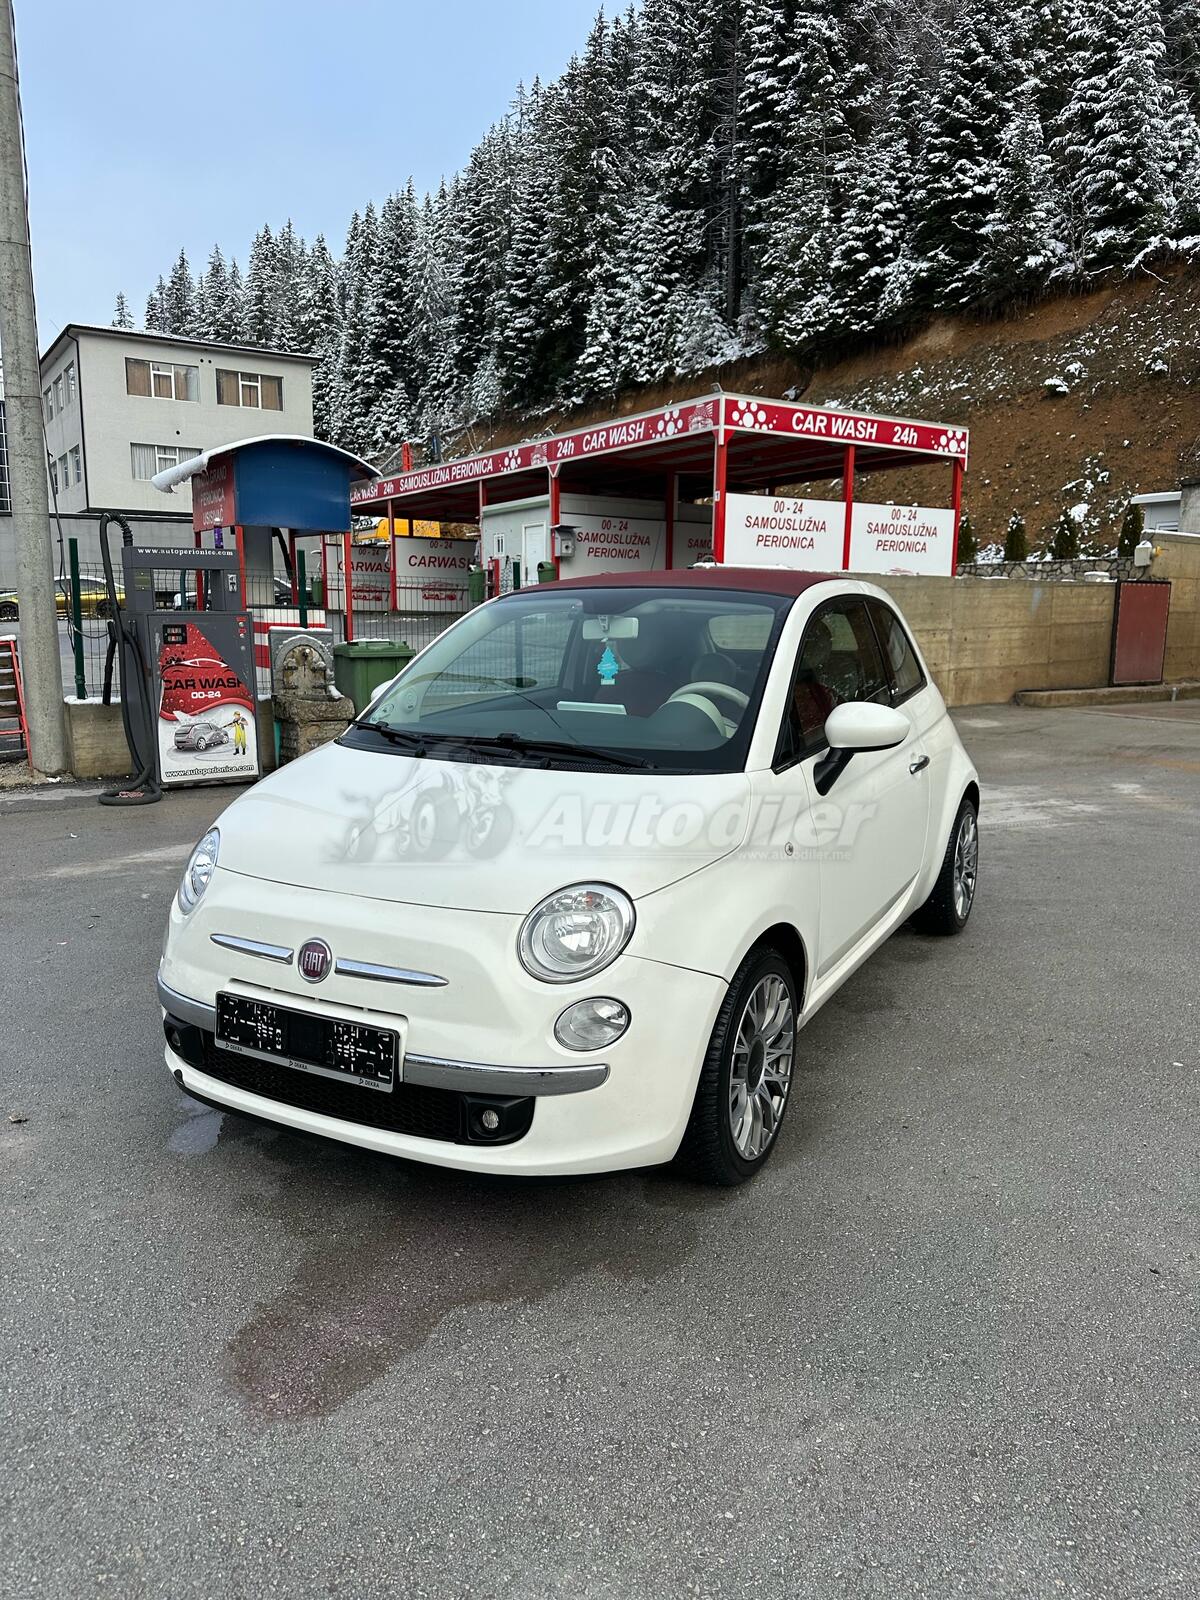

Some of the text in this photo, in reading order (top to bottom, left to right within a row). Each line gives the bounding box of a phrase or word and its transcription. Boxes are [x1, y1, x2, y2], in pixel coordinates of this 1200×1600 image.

[792, 411, 918, 445] CAR WASH 24h
[384, 481, 394, 495] 24h
[399, 467, 450, 492] SAMOUSLUŽNA
[451, 457, 493, 480] PERIONICA
[557, 440, 574, 458] 24h
[582, 432, 606, 452] CAR
[609, 421, 645, 444] WASH
[773, 500, 784, 513] 00
[793, 501, 804, 514] 24
[891, 508, 901, 520] 00
[907, 509, 917, 521] 24
[601, 519, 612, 531] 00
[619, 520, 629, 531] 24
[744, 515, 827, 533] SAMOUSLUŽNA
[866, 522, 938, 538] SAMOUSLUŽNA
[430, 540, 439, 549] 00
[576, 531, 650, 546] SAMOUSLUŽNA
[756, 534, 815, 550] PERIONICA
[137, 548, 233, 556] www.autoperionice.com
[876, 539, 927, 553] PERIONICA
[587, 547, 640, 560] PERIONICA
[163, 679, 197, 690] CAR
[191, 691, 221, 699] 00-24
[165, 764, 255, 777] www.autoperionice.com
[304, 951, 325, 972] FIAT
